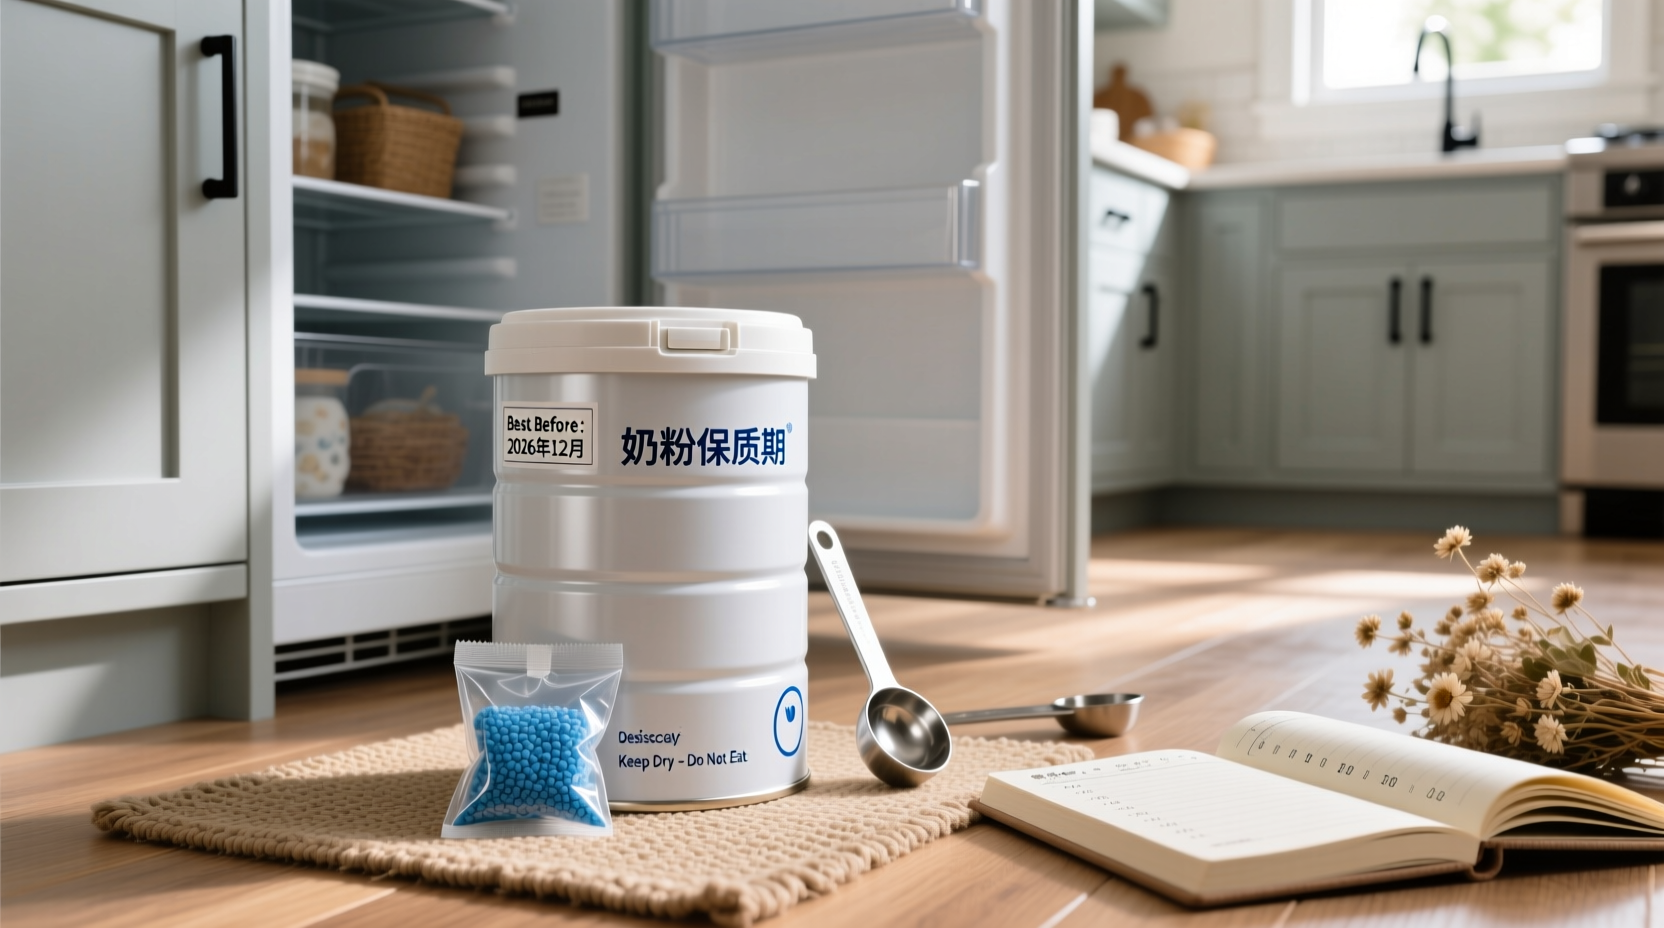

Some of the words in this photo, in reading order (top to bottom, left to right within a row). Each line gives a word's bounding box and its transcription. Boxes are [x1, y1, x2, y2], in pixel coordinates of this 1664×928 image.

[507, 415, 532, 432] Best
[507, 436, 584, 459] 2026年12月
[620, 426, 786, 467] 奶粉保质期
[618, 754, 650, 772] Keep
[653, 754, 675, 771] Dry
[687, 753, 704, 767] Do
[706, 751, 727, 766] Not
[729, 750, 748, 764] Eat
